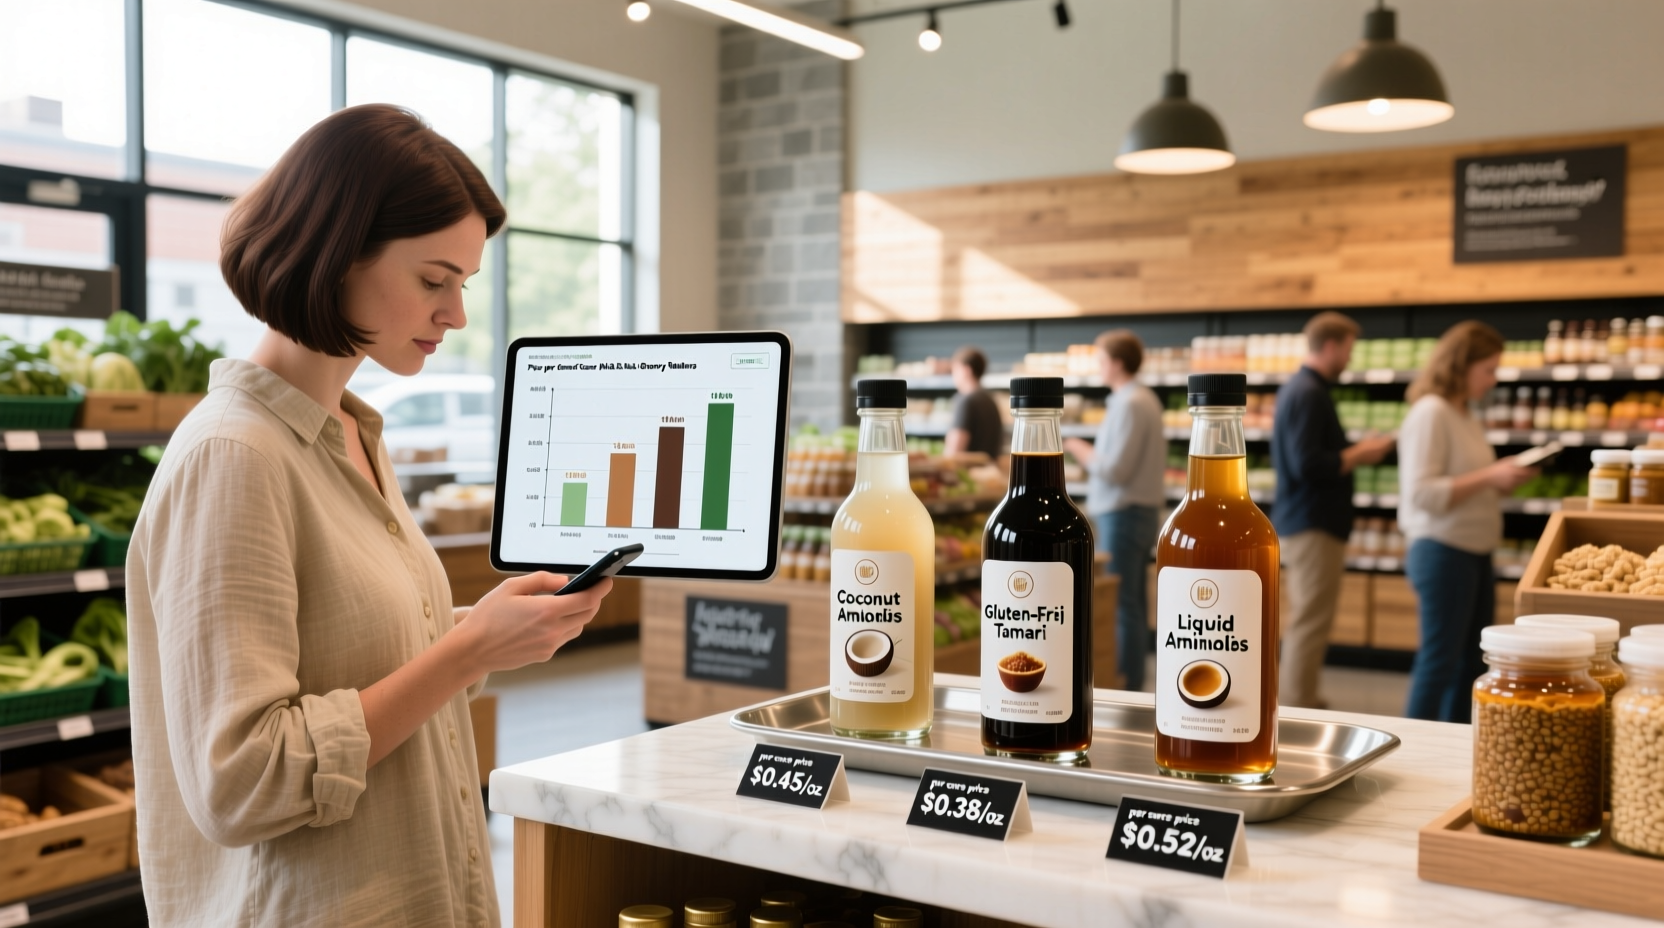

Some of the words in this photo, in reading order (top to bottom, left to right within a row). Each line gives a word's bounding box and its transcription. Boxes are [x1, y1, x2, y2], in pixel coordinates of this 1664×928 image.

[837, 589, 901, 606] Coconut
[993, 623, 1047, 640] Tamari
[1178, 614, 1235, 635] Liquid
[750, 765, 824, 797] $0.45/oz
[920, 791, 1005, 826] $0.38/oz
[1120, 821, 1225, 863] $0.52/oz
